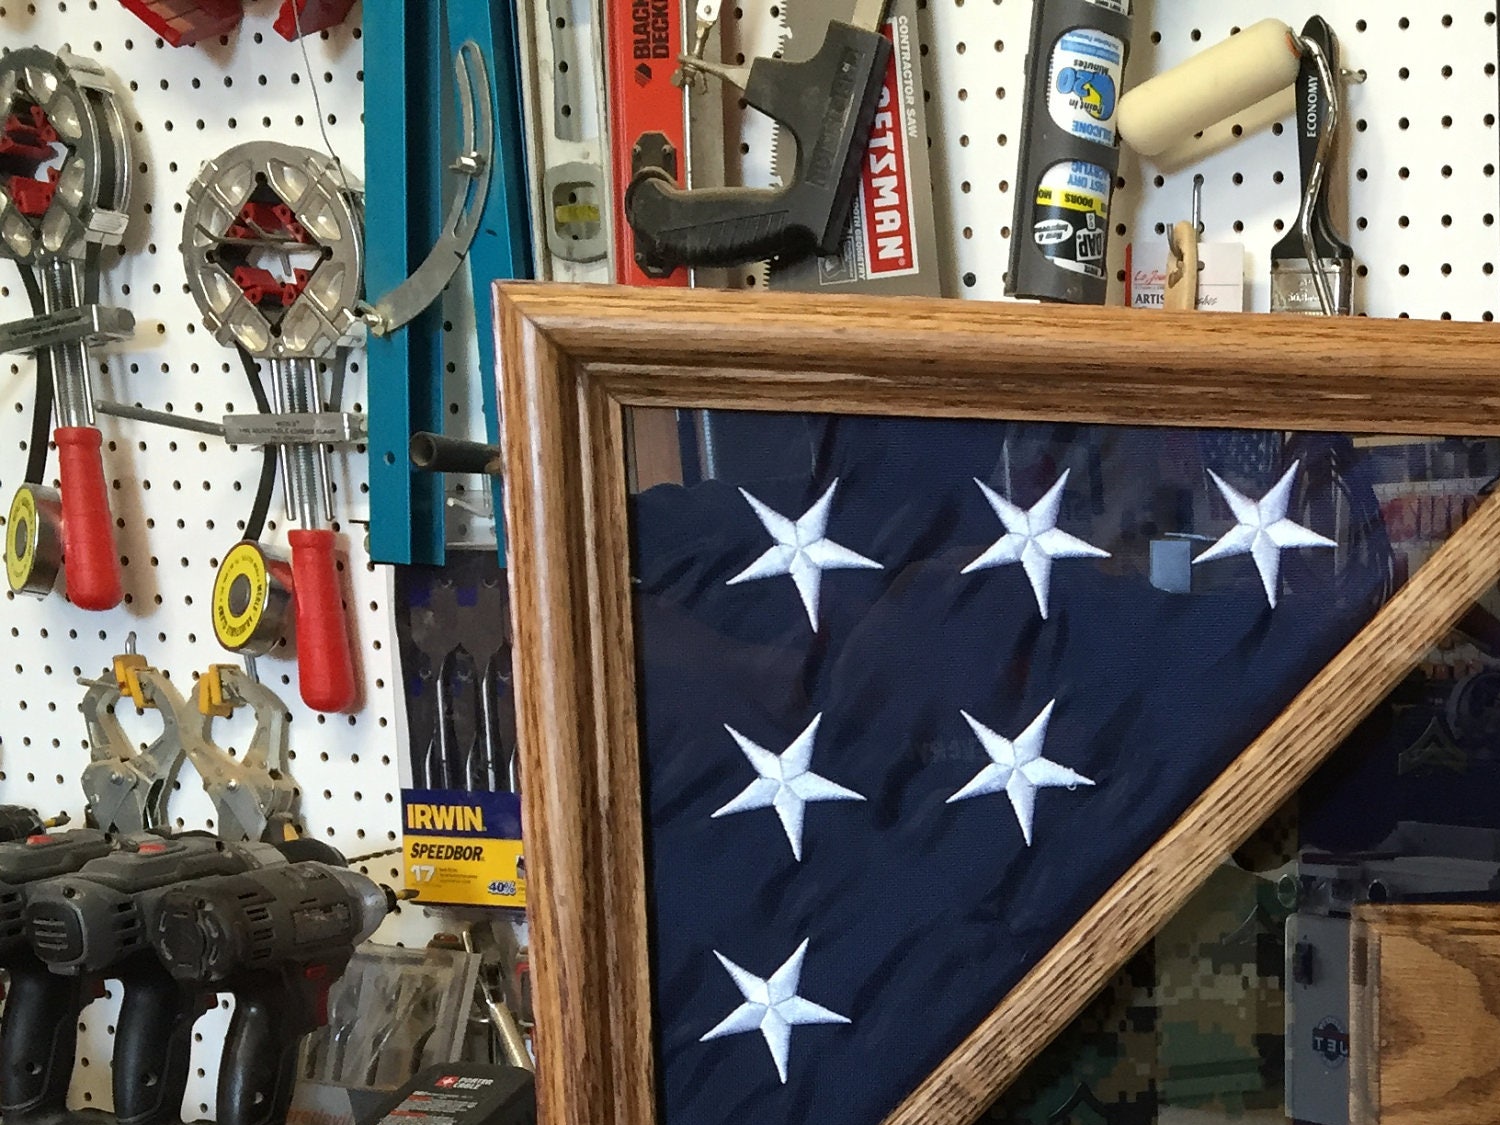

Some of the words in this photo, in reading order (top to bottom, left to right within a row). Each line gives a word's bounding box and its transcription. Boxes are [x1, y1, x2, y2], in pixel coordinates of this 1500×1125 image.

[652, 0, 669, 59] DECK
[898, 15, 915, 105] CONTRACTOR
[1073, 59, 1109, 75] Minutes
[1056, 67, 1095, 98] 20
[1069, 98, 1078, 110] in
[1080, 99, 1103, 114] Paint
[1307, 75, 1318, 138] ECONOMY
[906, 108, 918, 138] SAW
[868, 86, 905, 260] FTSMAN
[853, 198, 861, 228] OOTH
[1064, 193, 1094, 208] DOORS
[854, 229, 866, 280] GEOMETRY
[407, 803, 483, 832] IRWIN
[410, 842, 484, 861] SPEEDBOR
[411, 864, 435, 882] 17
[488, 881, 517, 896] 40%
